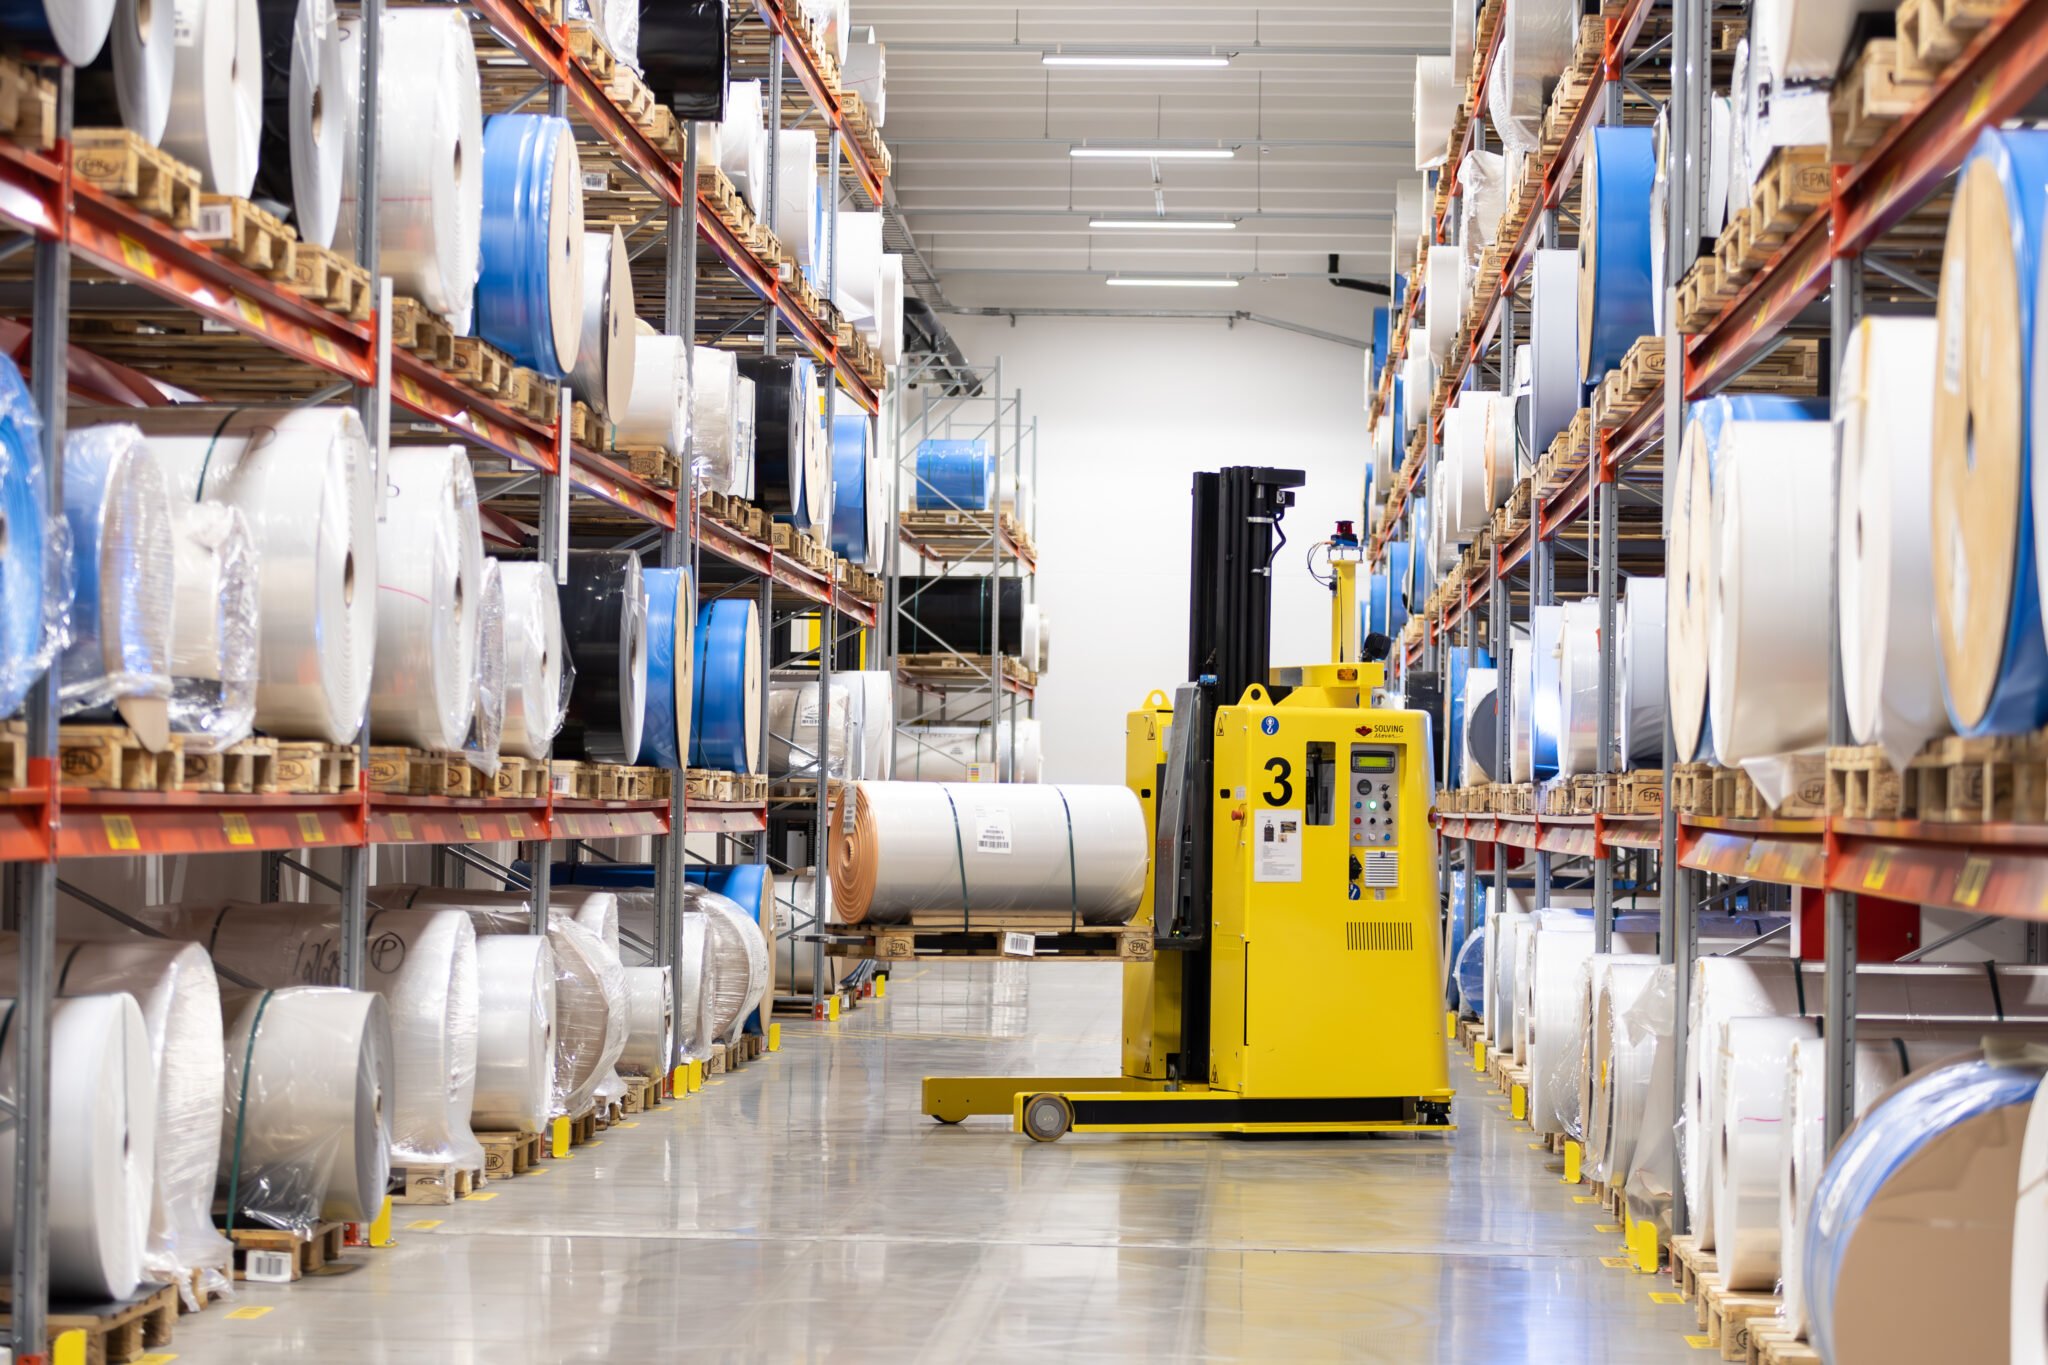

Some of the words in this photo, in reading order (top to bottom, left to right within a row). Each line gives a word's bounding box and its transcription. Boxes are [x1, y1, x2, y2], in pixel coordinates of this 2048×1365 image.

[1374, 725, 1404, 733] SOLVING
[1262, 757, 1293, 807] 3
[891, 942, 906, 952] EPAL
[1131, 941, 1147, 952] EPAL
